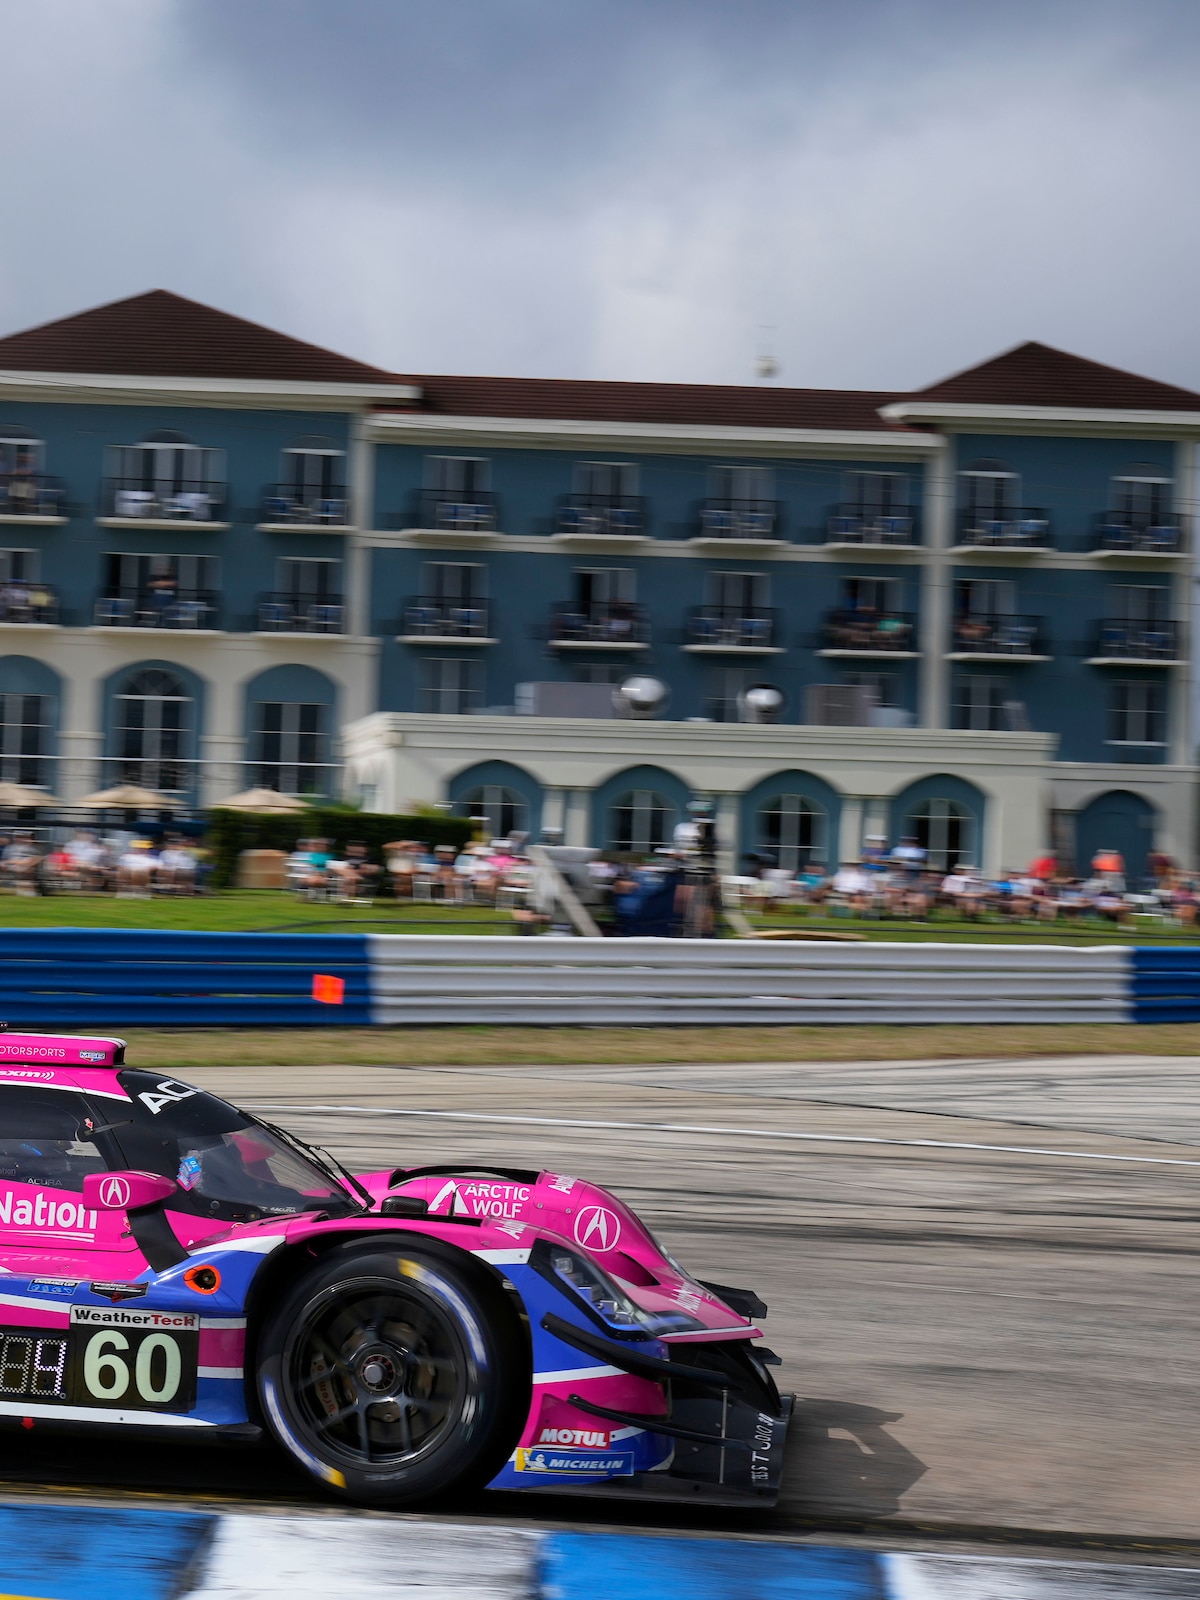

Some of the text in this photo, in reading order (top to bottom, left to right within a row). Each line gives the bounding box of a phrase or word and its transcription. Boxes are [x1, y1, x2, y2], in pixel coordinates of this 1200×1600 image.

[464, 1182, 530, 1202] ARCTIC
[472, 1200, 523, 1218] WOLF
[74, 1309, 195, 1327] WeatherTech
[83, 1330, 182, 1402] 60
[540, 1428, 607, 1446] MOTUL
[550, 1458, 624, 1470] MICHELIN
